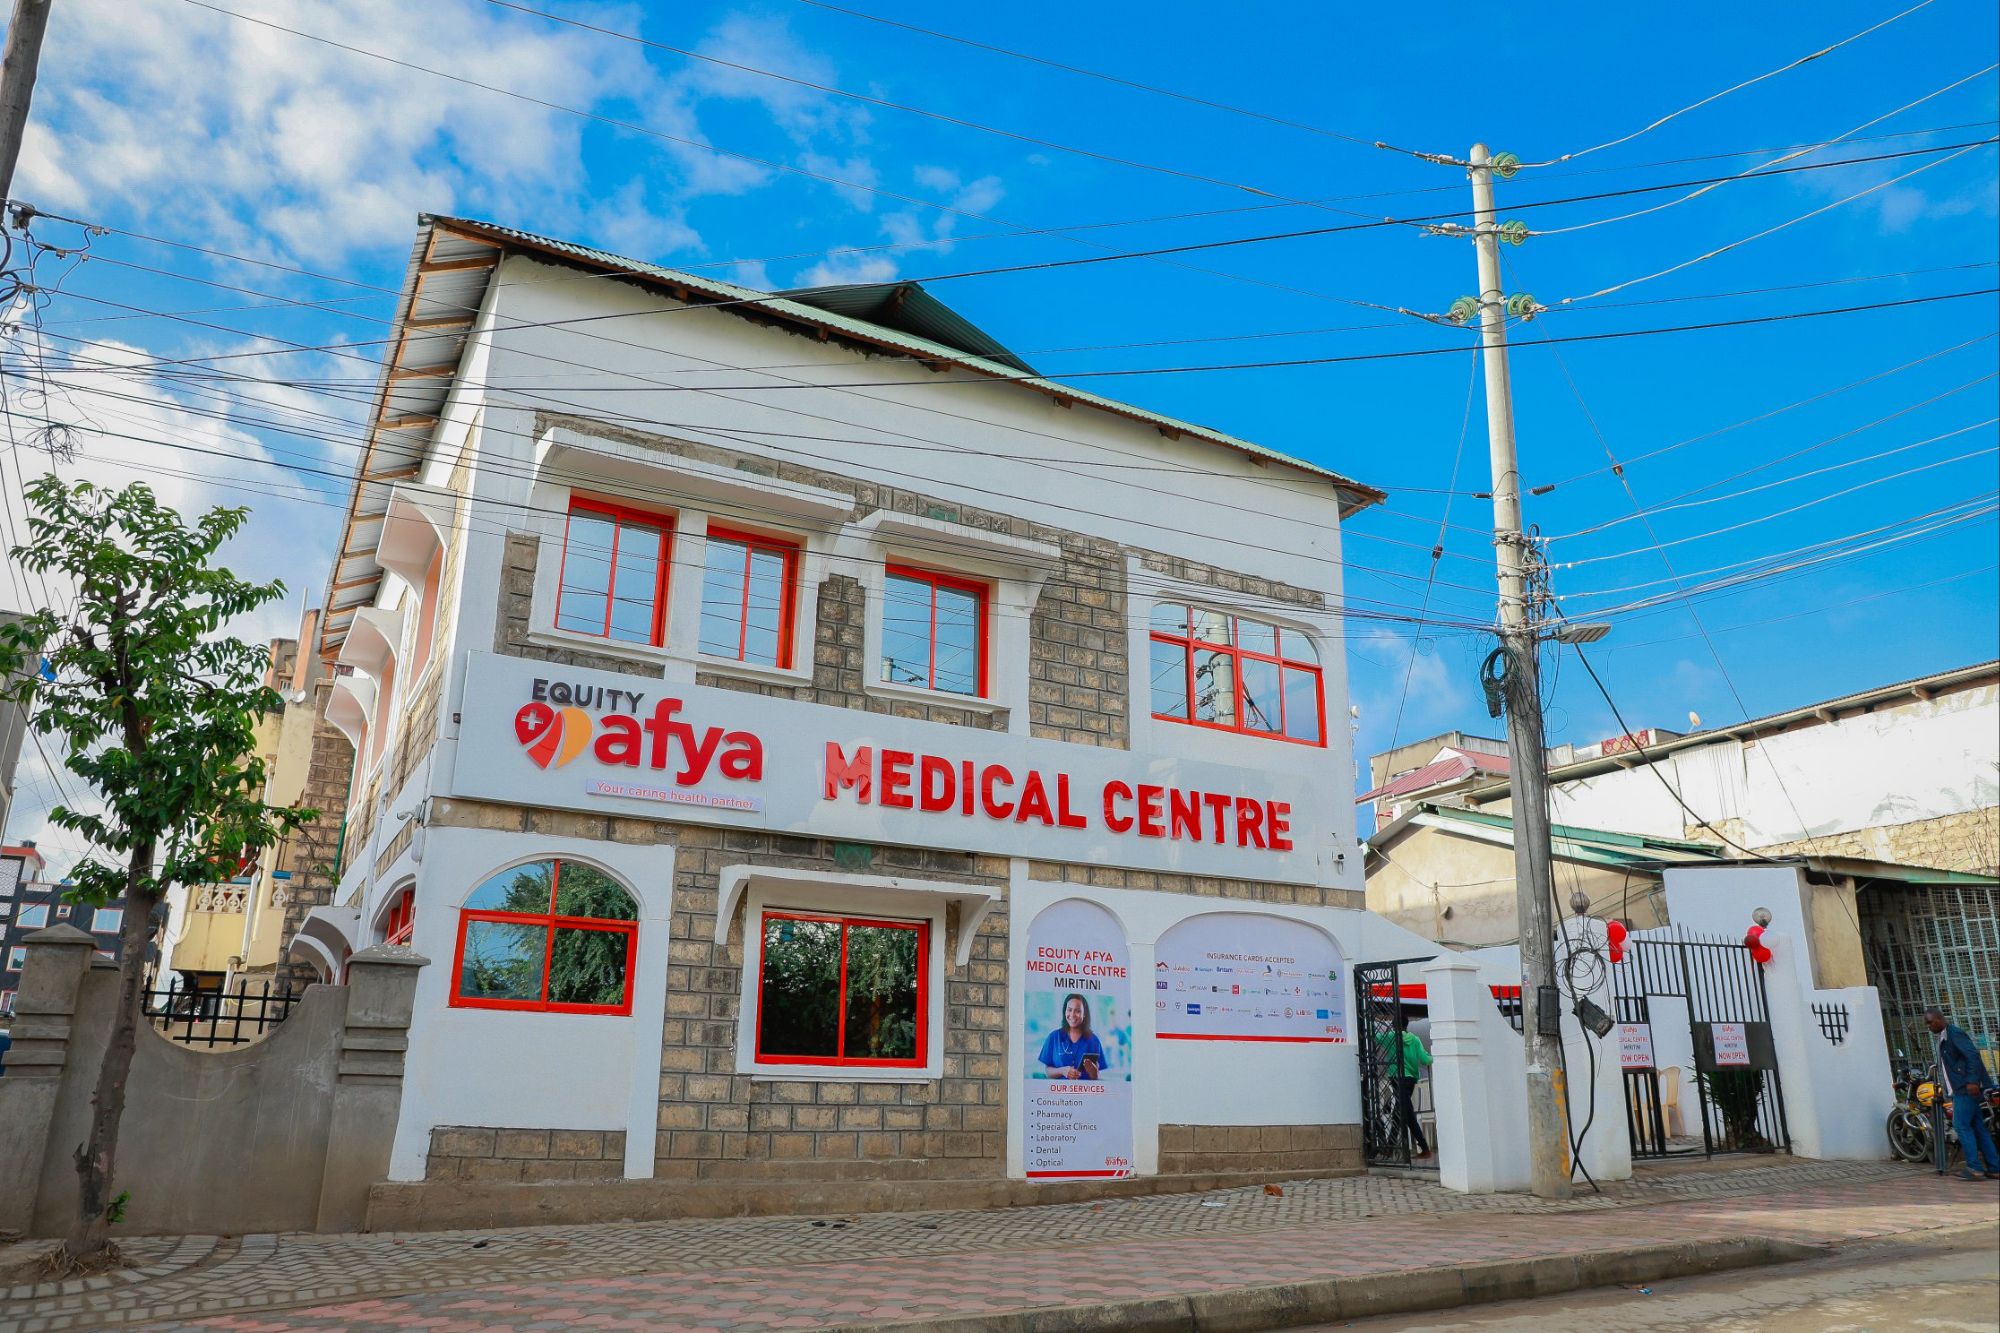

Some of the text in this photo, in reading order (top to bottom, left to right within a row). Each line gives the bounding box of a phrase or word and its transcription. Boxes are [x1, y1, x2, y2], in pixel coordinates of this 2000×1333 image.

[532, 678, 644, 714] EQUITY
[593, 697, 763, 787] afya
[596, 782, 754, 808] Your caring health partner
[824, 741, 1293, 851] MEDICAL CENTRE
[1038, 947, 1113, 962] EQUITY AFYA
[1206, 952, 1295, 964] INSURANCE CARDS ACCEPTED
[1027, 960, 1127, 978] MEDICAL CENTRE
[1054, 977, 1101, 990] MIRITINI
[1621, 1054, 1632, 1063] OW
[1050, 1084, 1105, 1093] OUR SERVICES
[1036, 1098, 1083, 1106] Consultation
[1036, 1110, 1072, 1120] Pharmacy
[1036, 1123, 1097, 1132] Specialist Clinics
[1036, 1134, 1076, 1143] Laboratory
[1036, 1146, 1061, 1154] Dental
[1036, 1159, 1064, 1168] Optical
